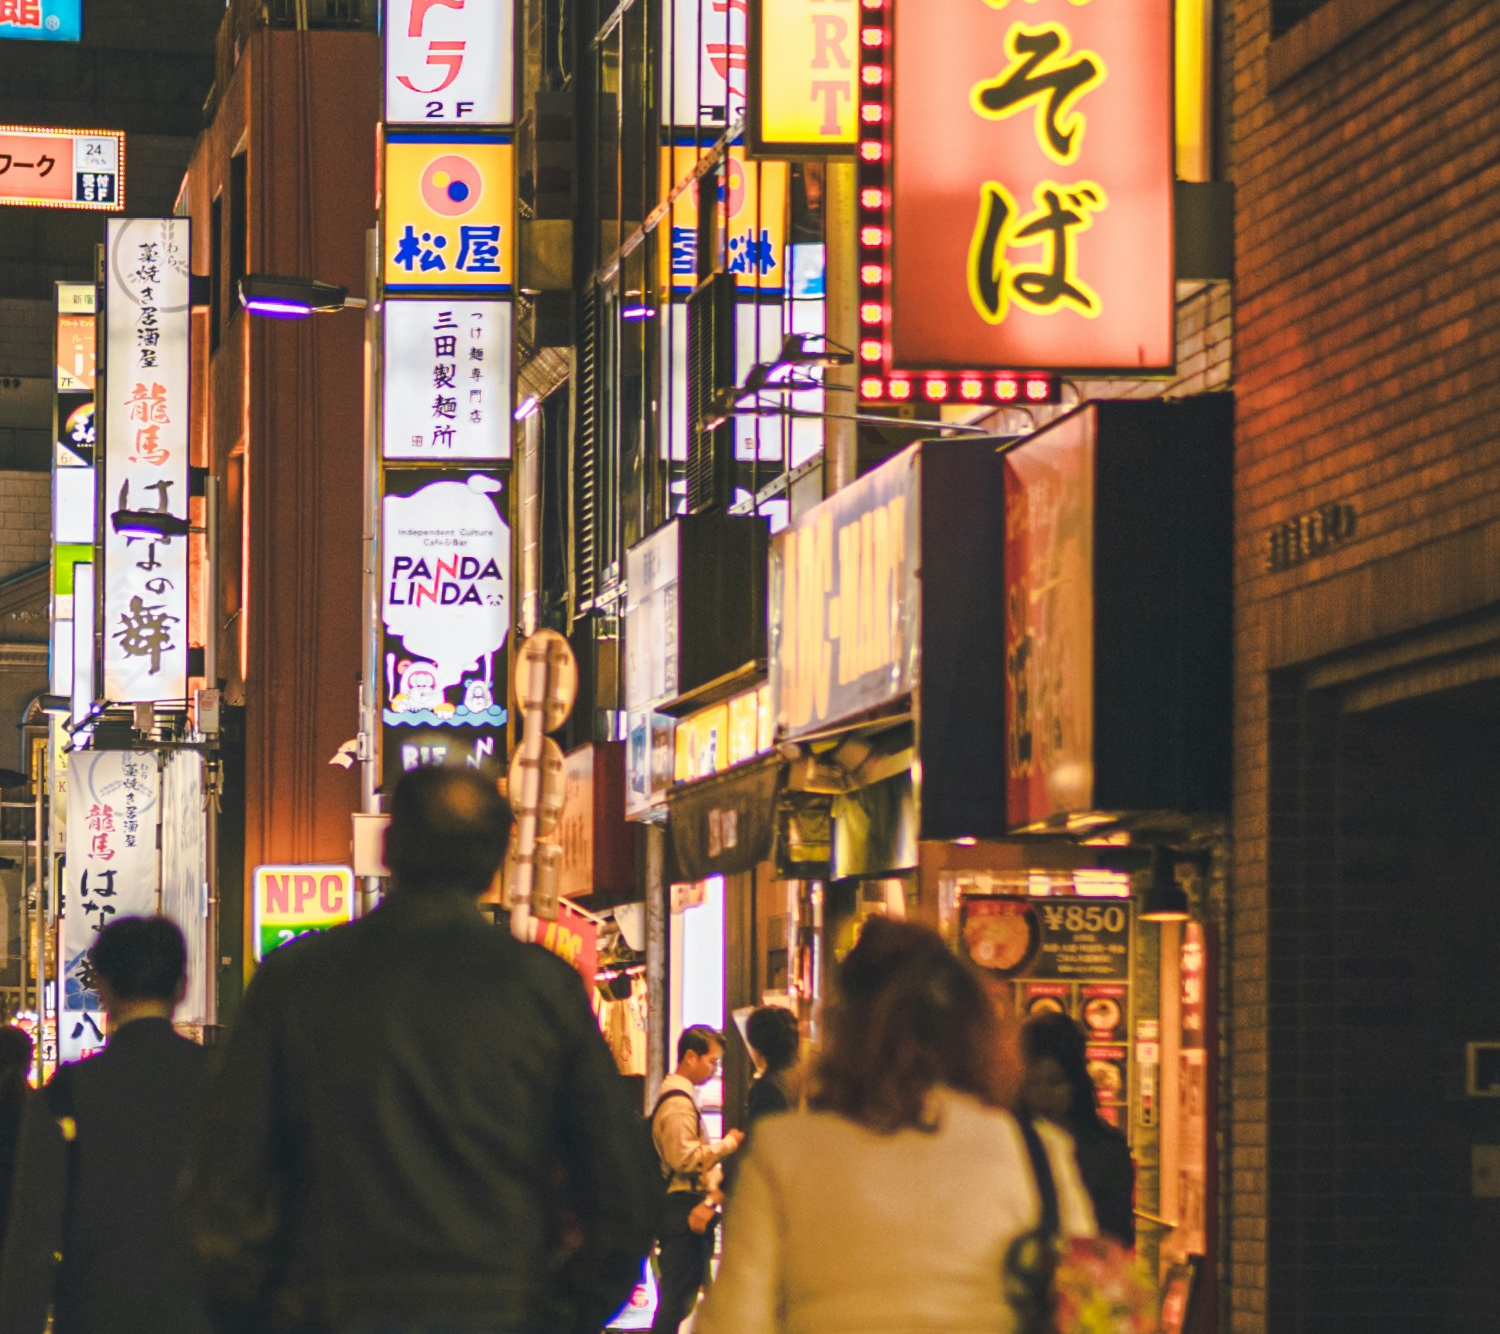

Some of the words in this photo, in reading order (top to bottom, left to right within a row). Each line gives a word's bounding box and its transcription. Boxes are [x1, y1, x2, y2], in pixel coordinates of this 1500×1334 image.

[424, 100, 475, 118] 2F
[85, 143, 103, 156] 24
[81, 173, 109, 188] 受付
[82, 186, 109, 202] 5F
[394, 224, 502, 275] 松屋
[60, 376, 74, 388] 7F
[431, 310, 459, 450] 三田製麺所
[469, 311, 485, 425] つけ麺専門店
[124, 381, 172, 467] 龍馬
[391, 553, 504, 581] PANDA
[388, 579, 484, 609] LINDA
[85, 803, 116, 862] 龍馬
[265, 874, 344, 914] NPC
[1043, 905, 1126, 934] ¥850
